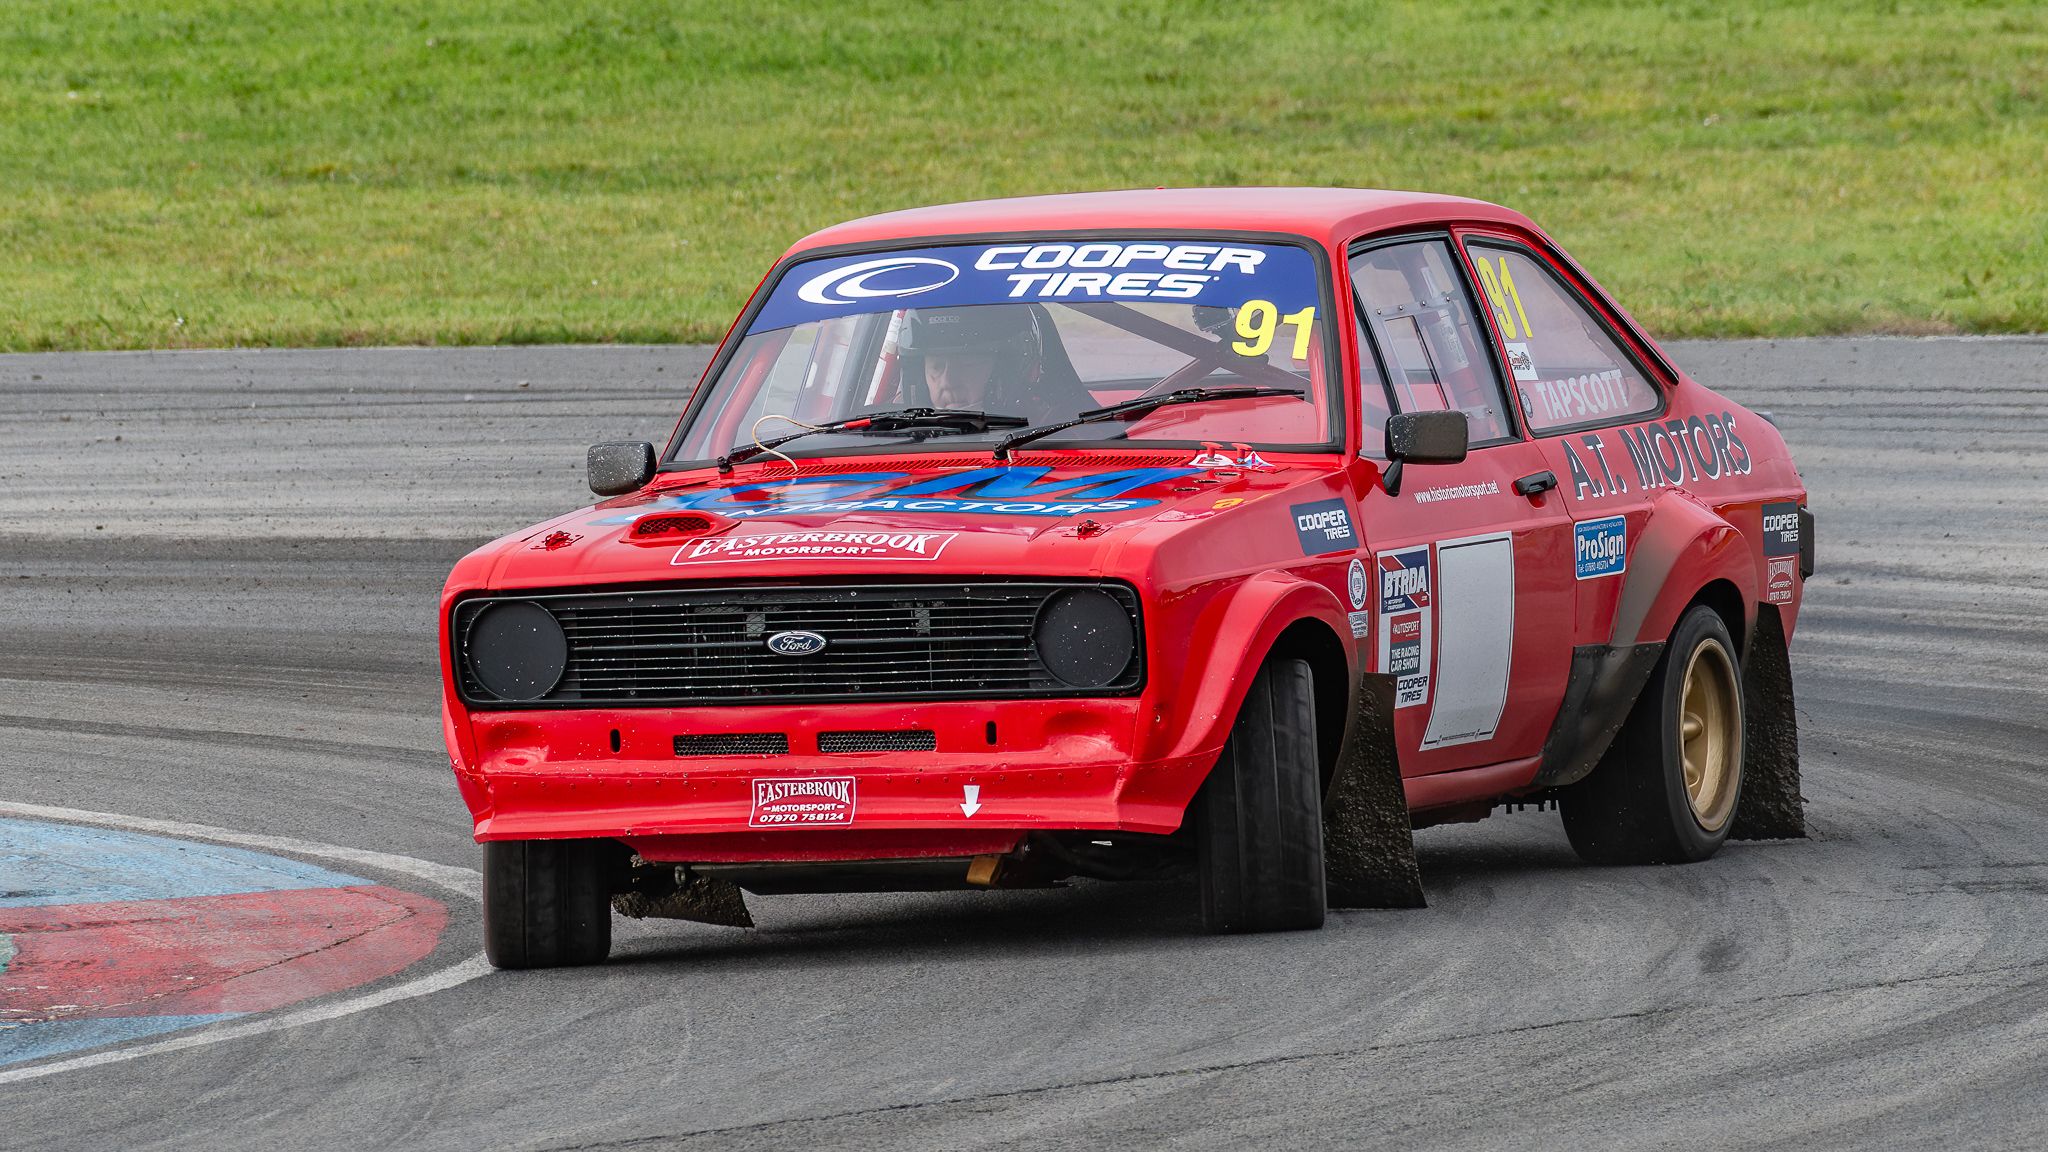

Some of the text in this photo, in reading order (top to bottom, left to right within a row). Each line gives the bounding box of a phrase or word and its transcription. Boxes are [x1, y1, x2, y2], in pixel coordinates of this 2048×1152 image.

[974, 244, 1266, 274] COOPER
[1007, 272, 1212, 298] TIRES
[1477, 256, 1534, 340] 91
[1231, 299, 1316, 361] 91
[1535, 369, 1629, 420] TAPSCOTT
[1561, 411, 1752, 500] A.T. MOTORS
[1413, 480, 1500, 503] www.historicmotorsport.net
[625, 499, 1138, 520] NTRACTORS
[1297, 509, 1348, 531] COOPER
[1323, 525, 1351, 540] TIRES
[1763, 513, 1799, 532] COOPER
[687, 532, 939, 559] EASTERBROOK
[1781, 530, 1799, 542] TIRES
[743, 545, 872, 557] MOTORSPORT
[1577, 531, 1624, 565] ProSign
[1383, 565, 1428, 599] BTRDA
[1393, 620, 1420, 635] AUTOSPORT
[780, 636, 812, 651] Ford
[1391, 645, 1420, 660] THE RACING
[1390, 656, 1420, 673] CAR SHOW
[1397, 675, 1428, 691] COOPER
[1400, 689, 1423, 704] TIRES
[757, 780, 851, 807] EASTERBROOK
[759, 812, 845, 823] 07970 758124
[770, 803, 837, 812] MOTORSPORT
